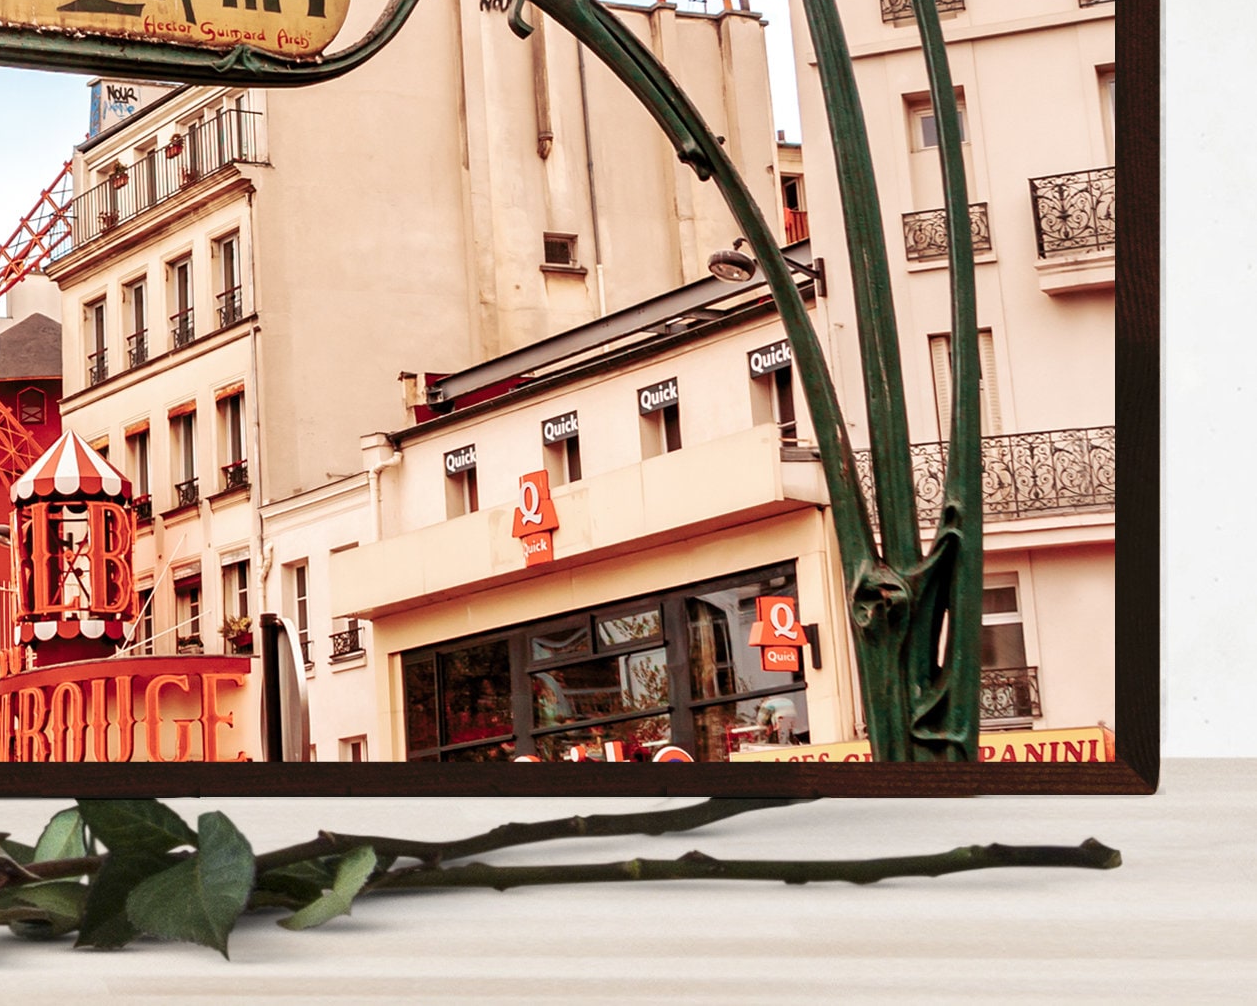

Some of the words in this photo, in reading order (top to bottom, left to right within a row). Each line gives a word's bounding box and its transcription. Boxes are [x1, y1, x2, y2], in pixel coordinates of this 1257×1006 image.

[144, 15, 192, 35] Hector
[200, 21, 266, 42] Guimard
[750, 342, 792, 374] Quick
[640, 381, 678, 410] Quick
[544, 414, 579, 441] Quick
[446, 447, 478, 472] Quick
[519, 481, 543, 526] Q
[523, 539, 548, 558] Quick
[770, 603, 798, 640] Q
[767, 650, 796, 663] Quick
[19, 674, 249, 762] ROUGE
[978, 739, 1100, 762] PANINI
